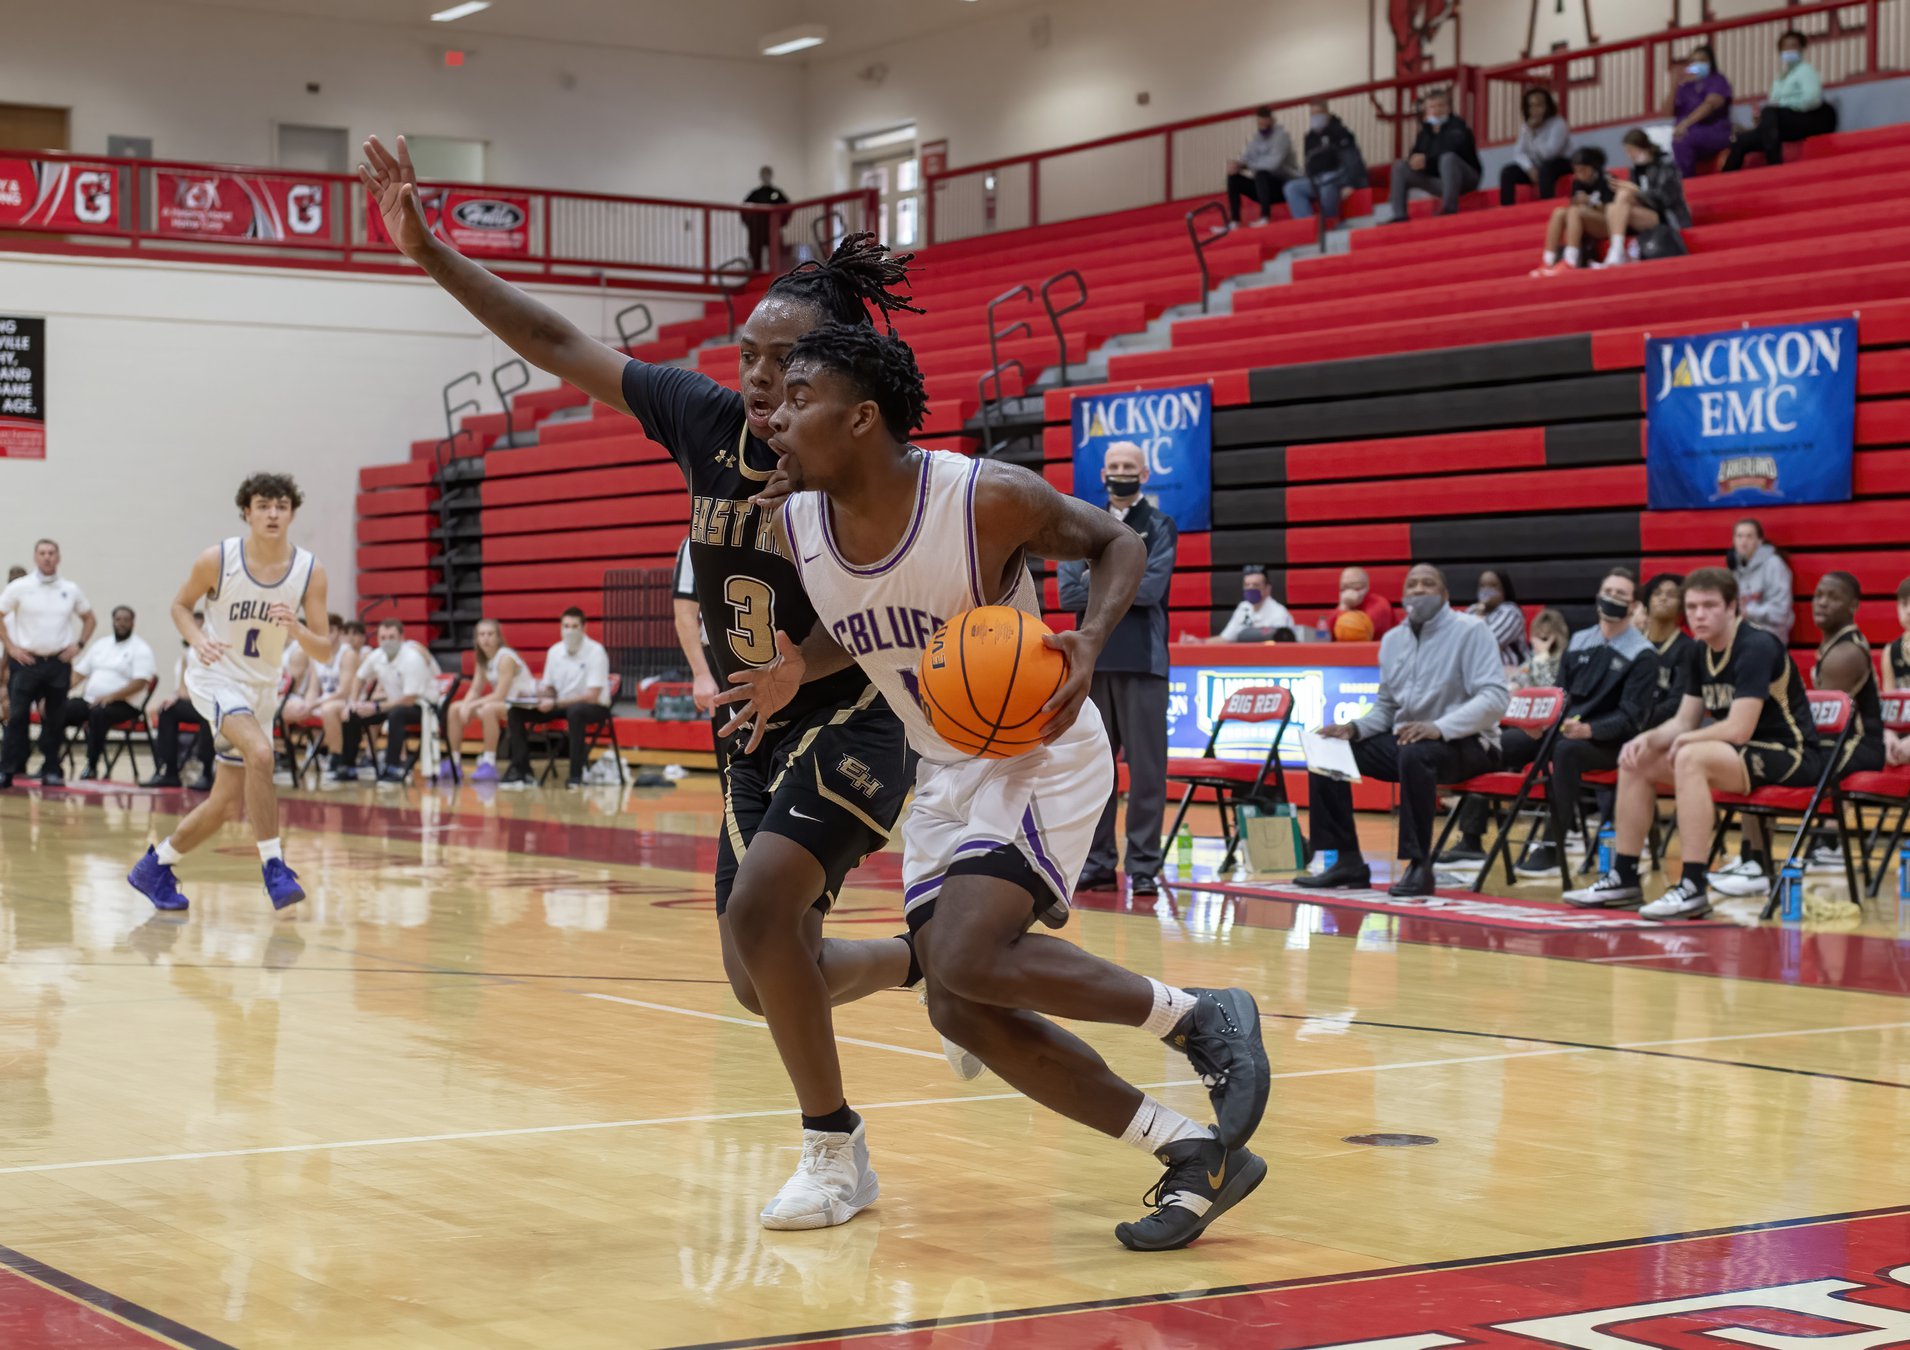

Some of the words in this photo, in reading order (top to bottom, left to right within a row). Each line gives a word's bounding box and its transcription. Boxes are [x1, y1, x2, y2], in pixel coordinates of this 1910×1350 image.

[1656, 327, 1843, 401] JACKSON
[1078, 390, 1202, 448] JACKSON
[1698, 384, 1798, 437] EMC
[724, 575, 780, 668] 3
[1227, 694, 1253, 714] BIG
[1254, 693, 1282, 713] RED
